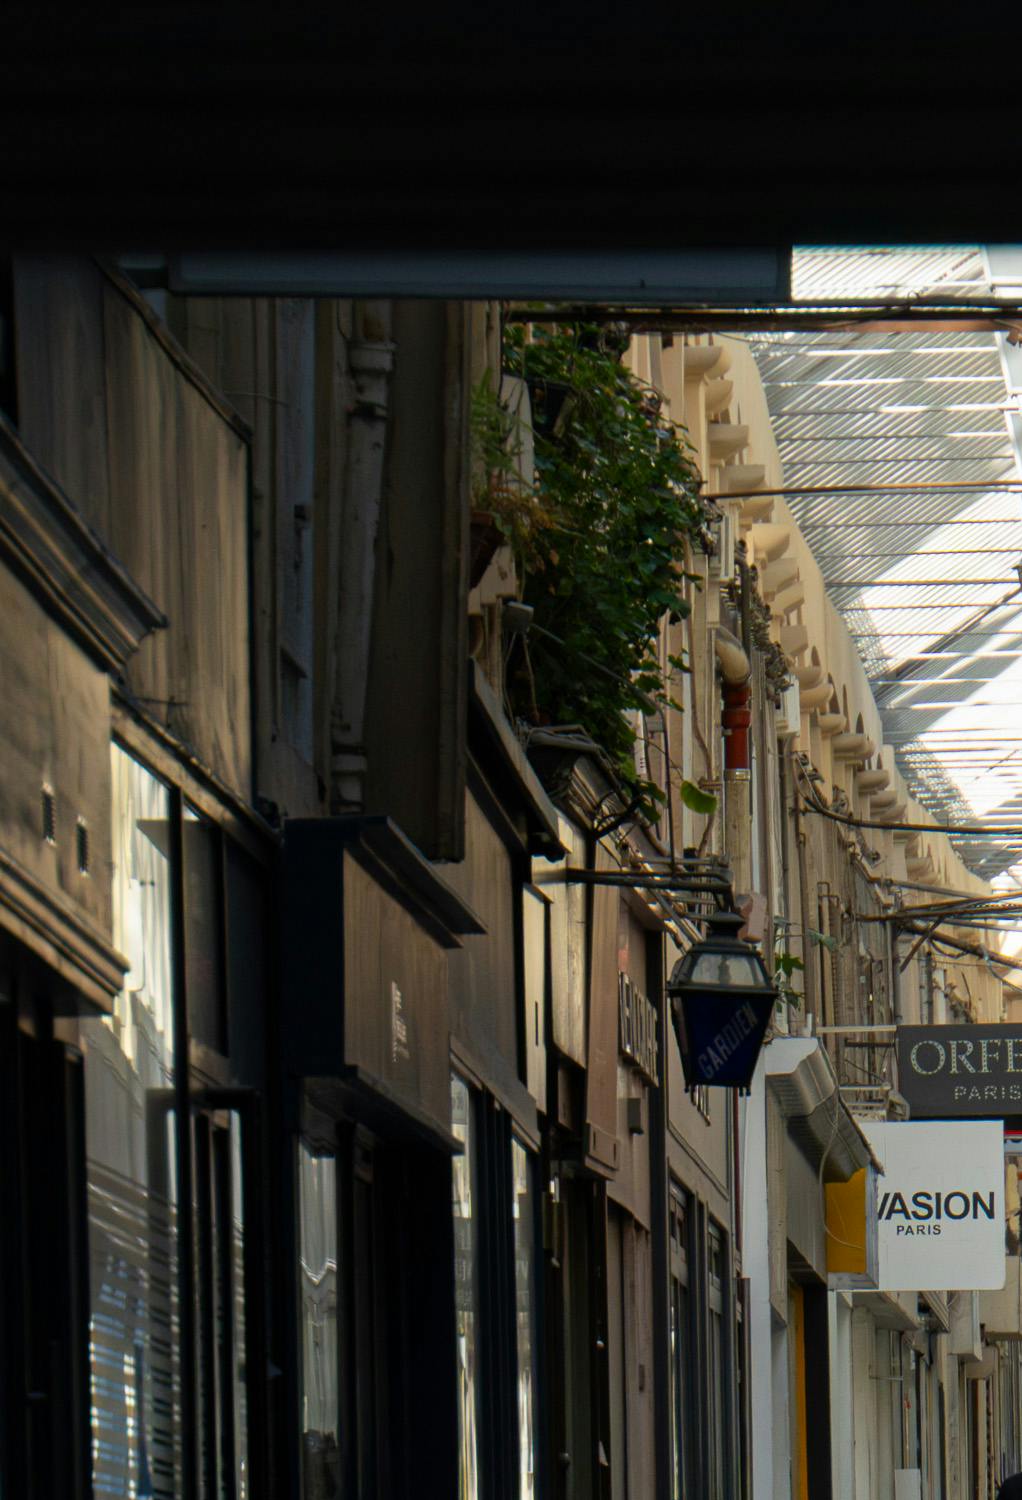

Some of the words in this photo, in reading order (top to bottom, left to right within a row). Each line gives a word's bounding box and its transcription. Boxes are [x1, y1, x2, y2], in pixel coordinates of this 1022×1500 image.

[697, 1000, 759, 1080] GARDIEN
[954, 1084, 1022, 1100] PARIS
[896, 1225, 942, 1236] PARIS
